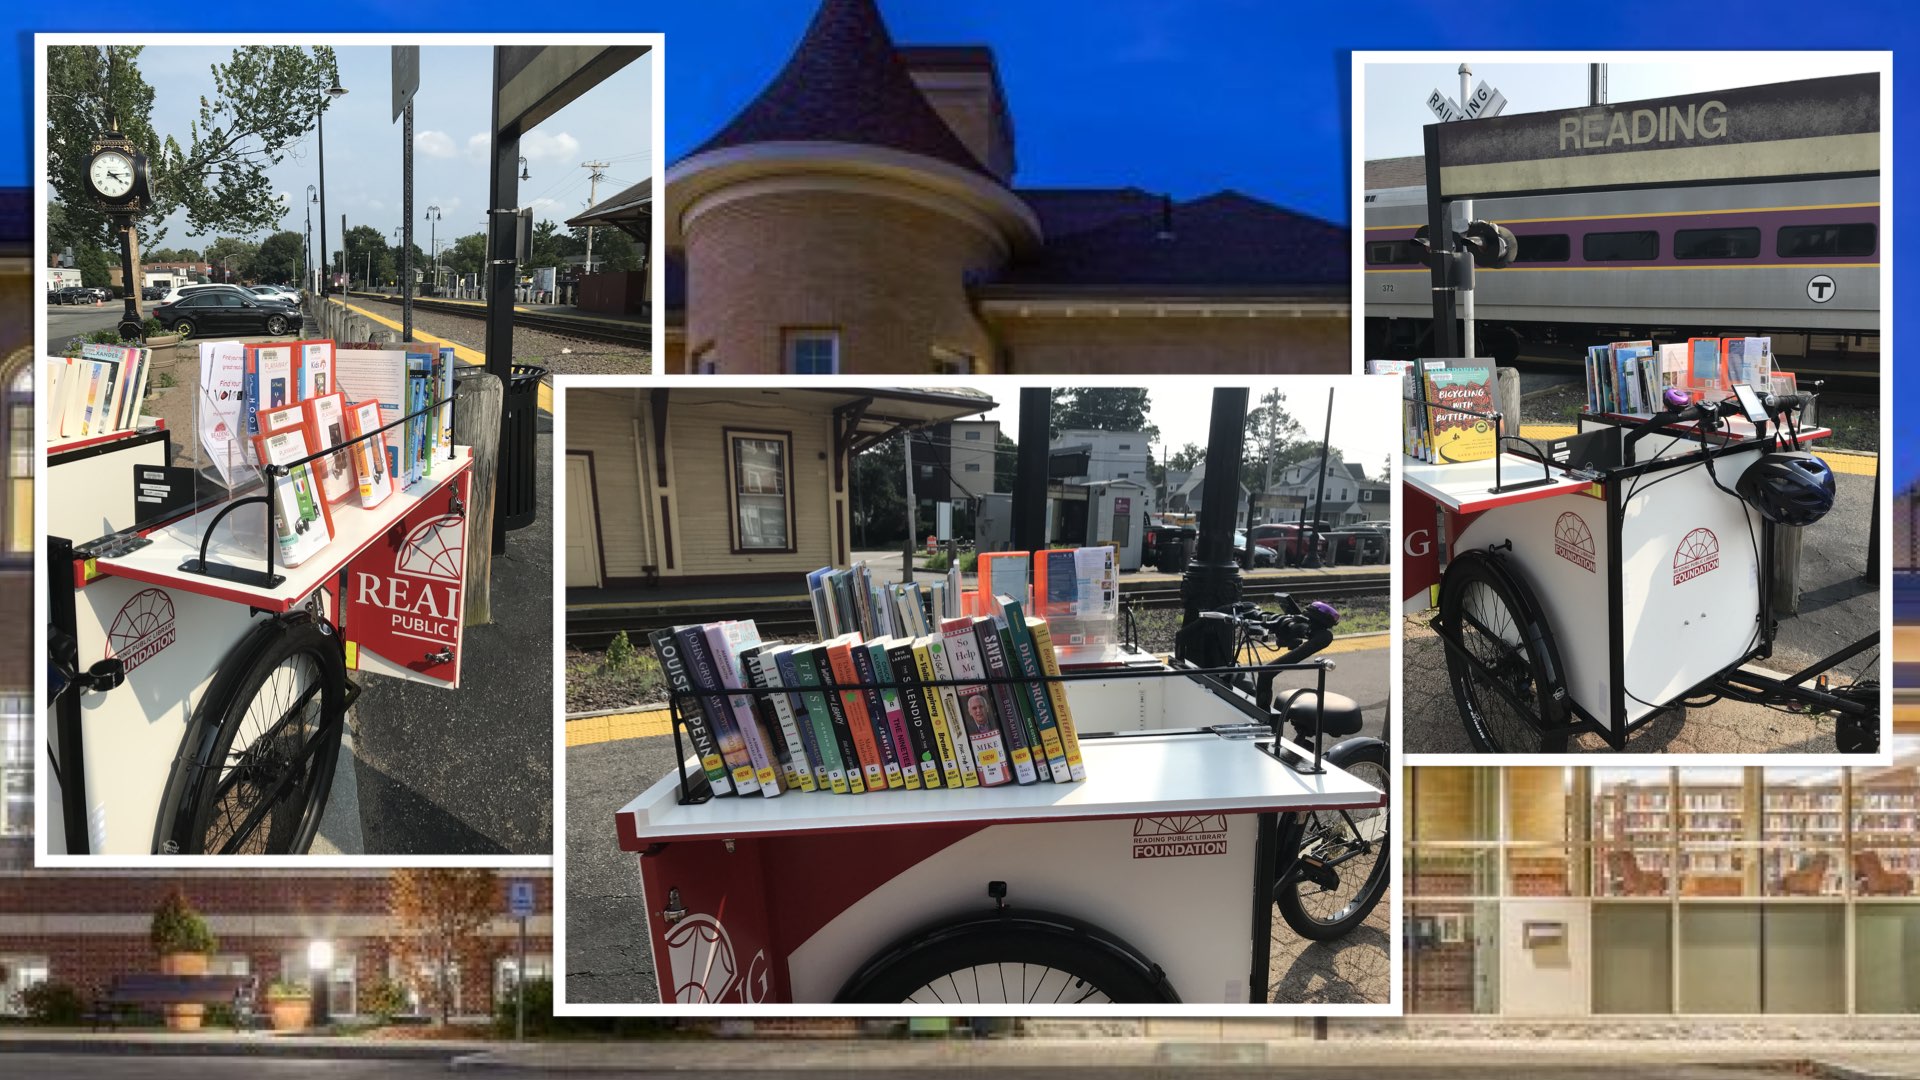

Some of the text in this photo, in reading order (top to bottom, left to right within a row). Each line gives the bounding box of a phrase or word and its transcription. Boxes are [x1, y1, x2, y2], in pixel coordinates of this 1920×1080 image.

[1559, 100, 1727, 150] READING
[1382, 284, 1394, 292] 372
[1811, 282, 1832, 299] T
[1438, 389, 1484, 399] BICYCLING
[249, 397, 257, 431] HOOT
[1452, 401, 1473, 409] WITH
[1555, 546, 1596, 572] FOUNDATION
[1703, 553, 1719, 564] LIBRARY
[1674, 560, 1719, 584] FOUNDATION
[391, 614, 449, 637] PUBLIC
[132, 621, 175, 652] PUBLIC LIBRARY
[685, 632, 705, 660] JOHN
[956, 639, 968, 648] So
[123, 631, 176, 671] UNDATION
[891, 654, 911, 662] LARSON
[955, 650, 976, 661] Help
[984, 634, 1004, 669] SAVED
[747, 657, 770, 701] ADRIT
[843, 661, 852, 681] Talkin
[858, 652, 877, 704] MERCY SEET
[962, 664, 975, 673] Me
[801, 661, 823, 713] TRST
[920, 662, 929, 681] Violin
[927, 685, 938, 717] onspiracy
[903, 676, 923, 727] SLENDID
[1043, 649, 1058, 686] BICYCLIG
[1057, 704, 1076, 752] BUTTERFLIES
[1003, 699, 1019, 743] BENJAMIN
[879, 726, 893, 760] JENNIFER
[897, 734, 912, 767] NINETIES
[937, 732, 949, 760] Brendan
[977, 741, 999, 751] MIKE
[1047, 746, 1060, 754] NEW
[706, 759, 719, 767] NEW
[1015, 752, 1027, 760] NEW
[1067, 754, 1080, 762] NEW
[736, 770, 749, 778] NEW
[759, 771, 771, 779] NEW
[1133, 833, 1227, 844] READING PUBLIC LIBRARY
[1134, 841, 1227, 858] FOUNDATION
